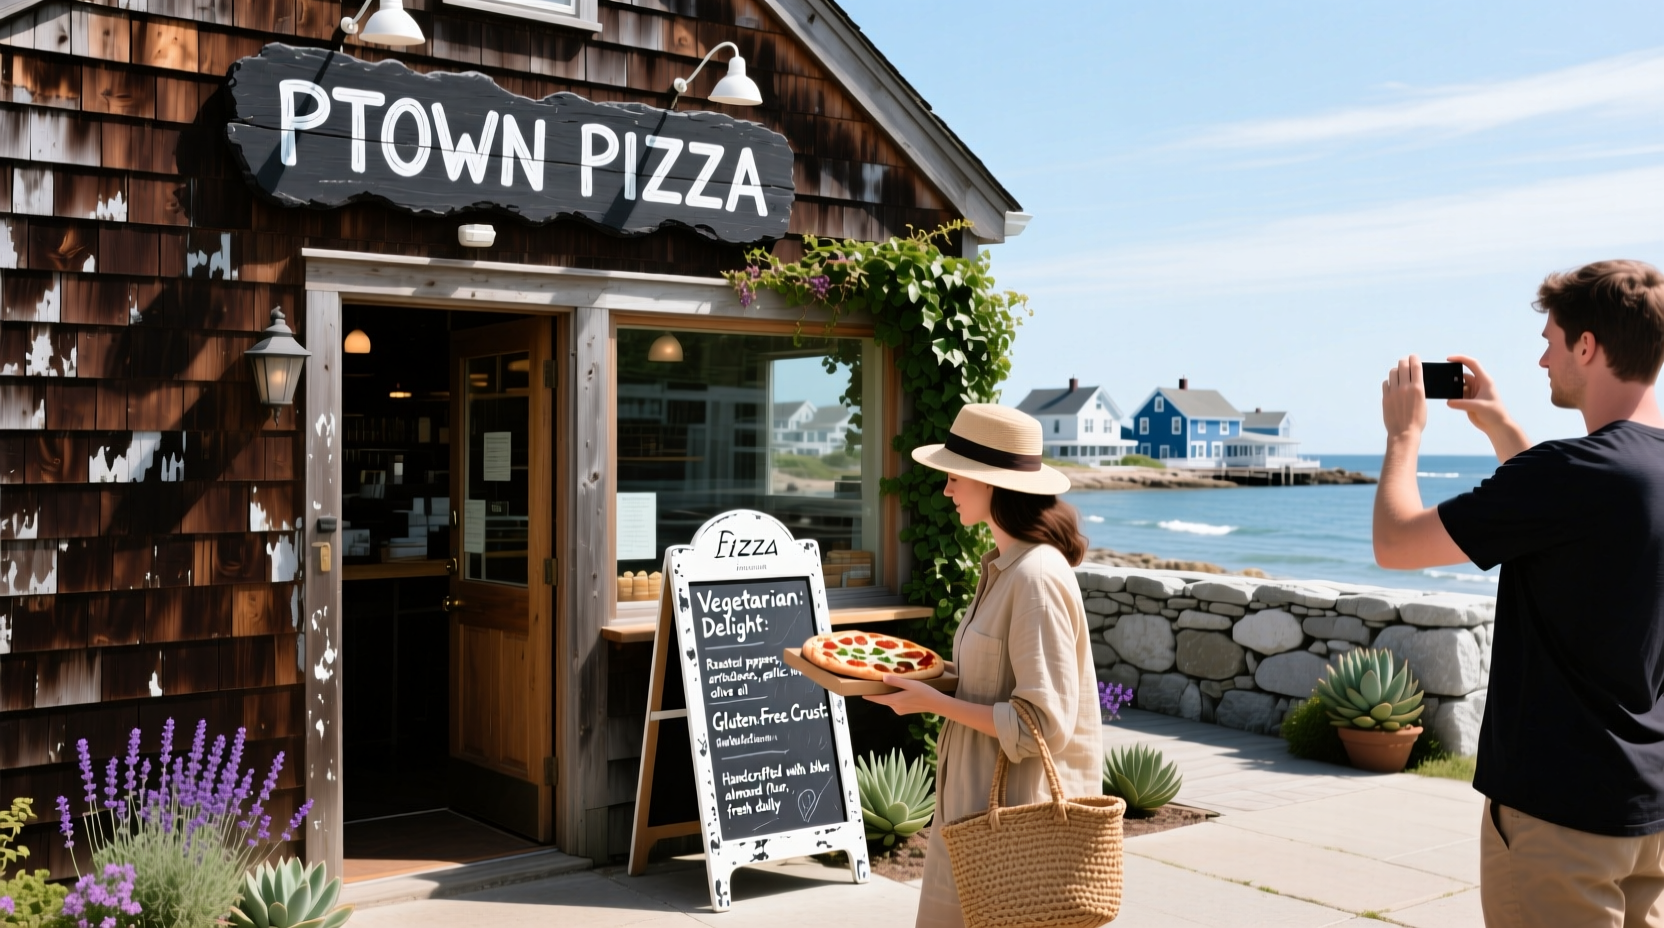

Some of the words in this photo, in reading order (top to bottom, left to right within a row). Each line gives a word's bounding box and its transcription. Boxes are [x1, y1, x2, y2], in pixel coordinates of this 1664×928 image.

[279, 79, 546, 192] PTOWN
[580, 123, 768, 217] PIZZA
[702, 613, 769, 643] Delight:
